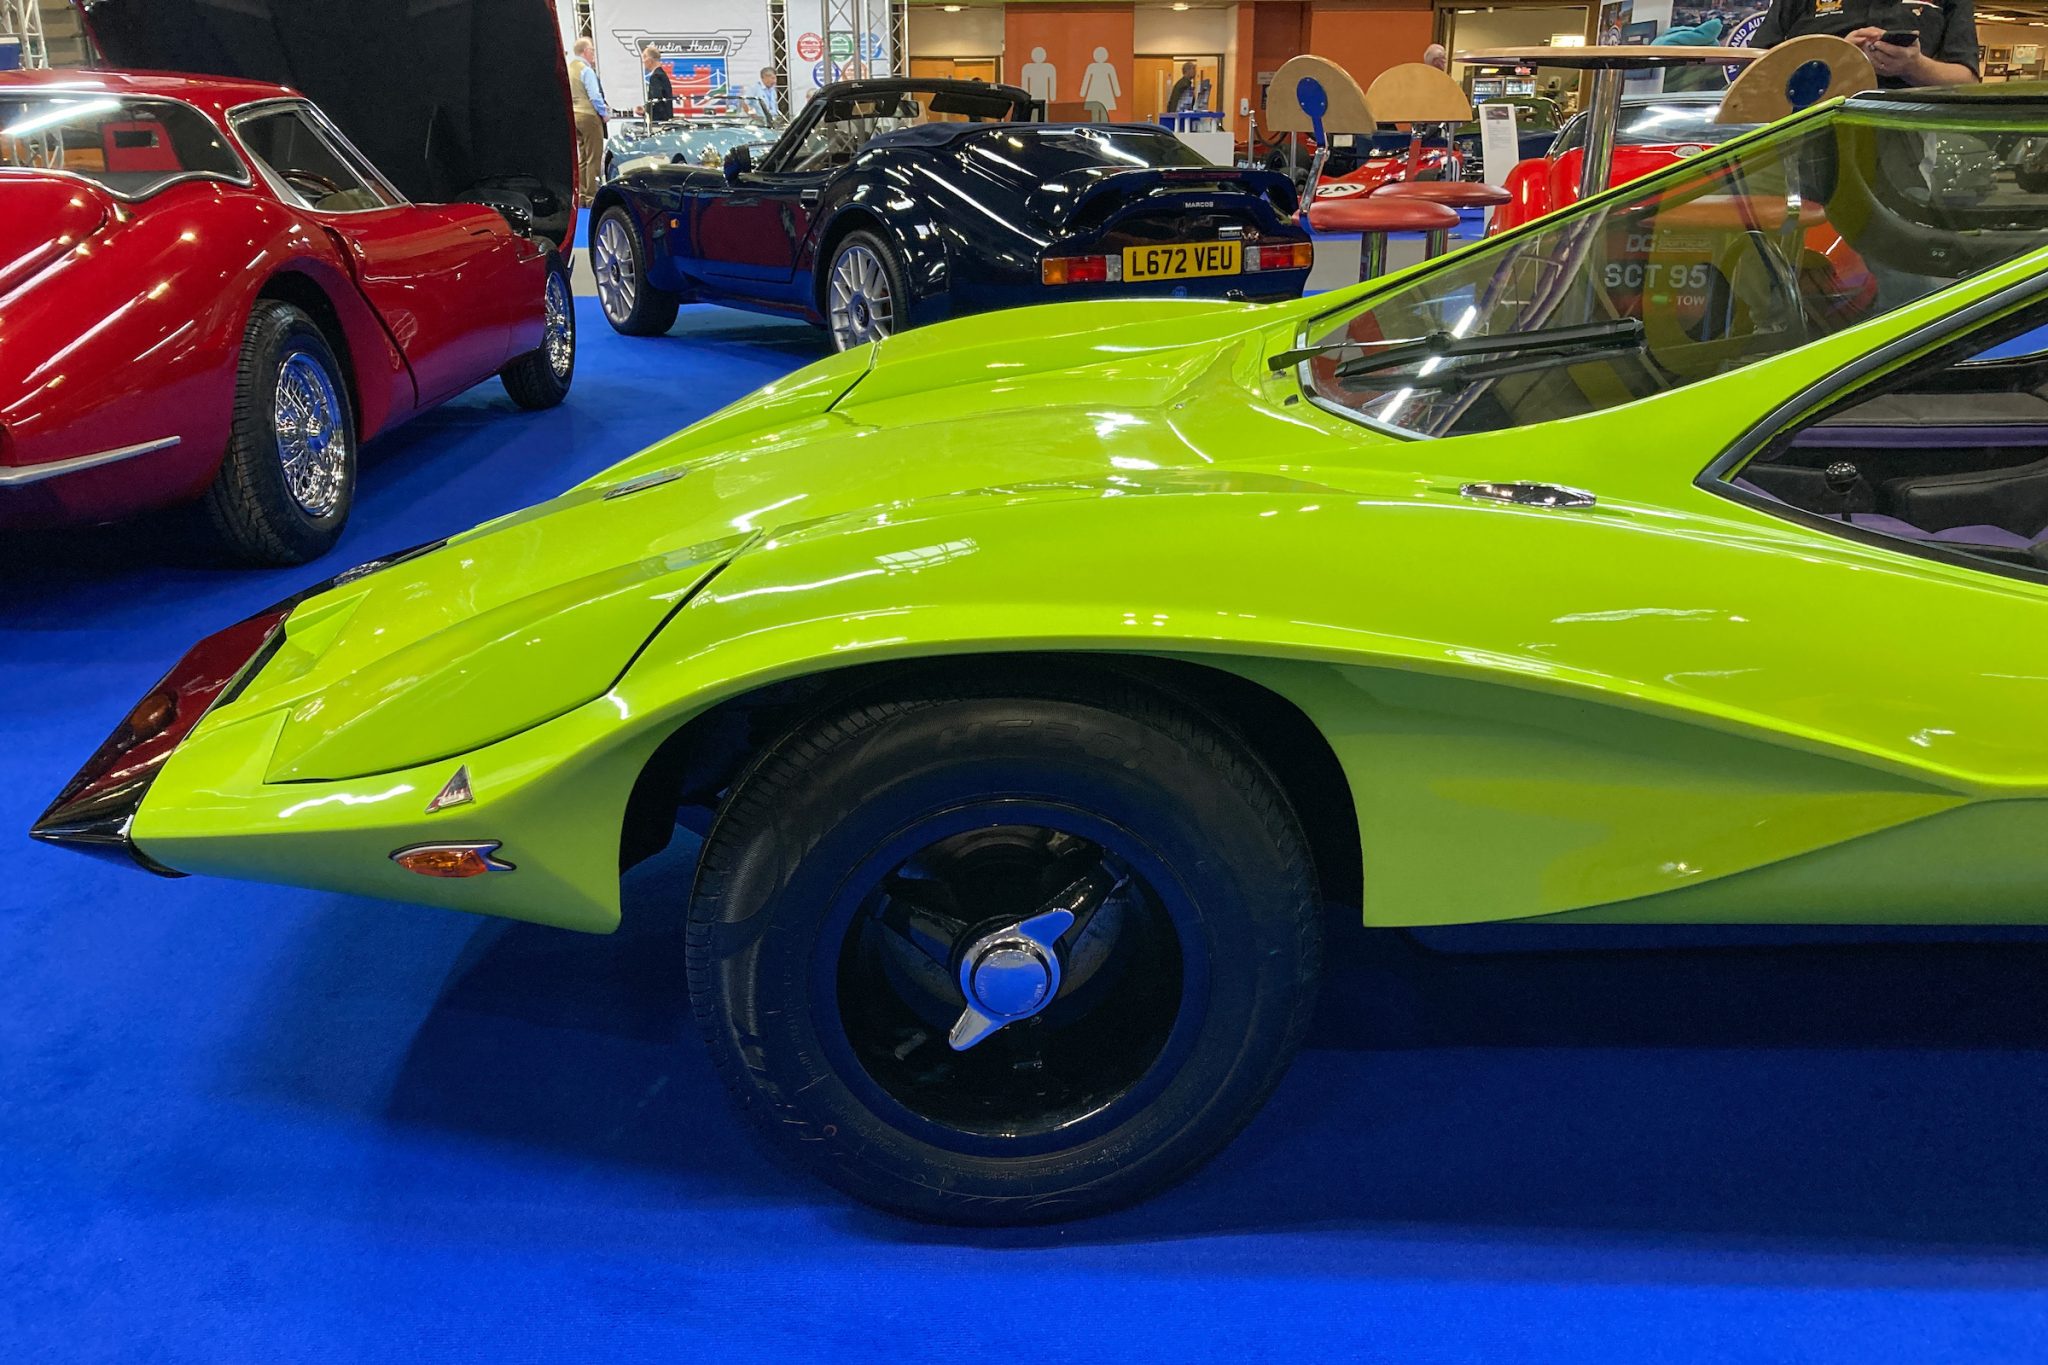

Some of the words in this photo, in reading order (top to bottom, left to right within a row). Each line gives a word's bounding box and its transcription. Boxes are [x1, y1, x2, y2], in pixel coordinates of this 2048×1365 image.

[687, 40, 724, 53] Healey
[1132, 249, 1187, 276] L672
[1194, 246, 1232, 270] VEU
[1604, 264, 1663, 288] SCT
[1669, 265, 1708, 288] 95
[1676, 296, 1705, 305] TOW
